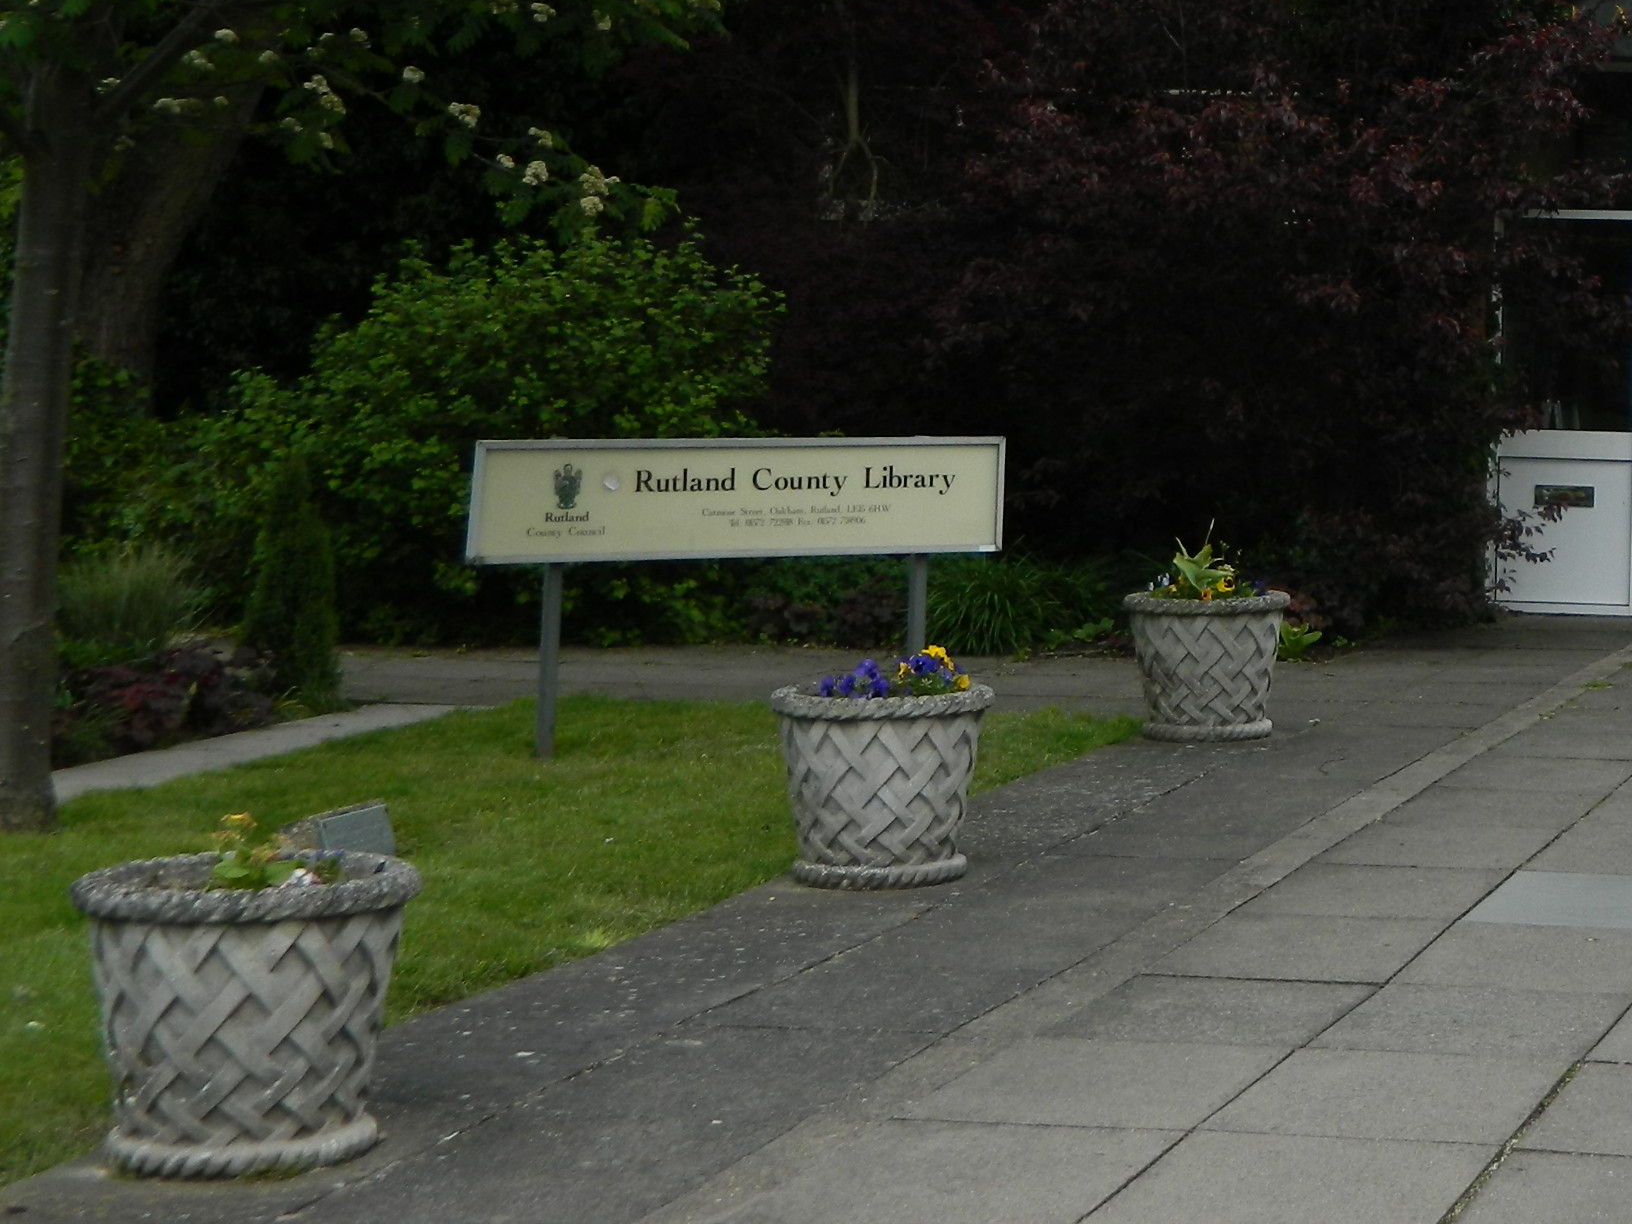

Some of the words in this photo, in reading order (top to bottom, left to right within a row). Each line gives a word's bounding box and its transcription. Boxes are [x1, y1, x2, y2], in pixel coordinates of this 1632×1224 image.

[635, 468, 736, 493] Rutland
[752, 468, 848, 497] County
[864, 465, 956, 495] Library
[545, 511, 590, 522] Rutland
[527, 527, 562, 539] County
[569, 526, 605, 536] Council
